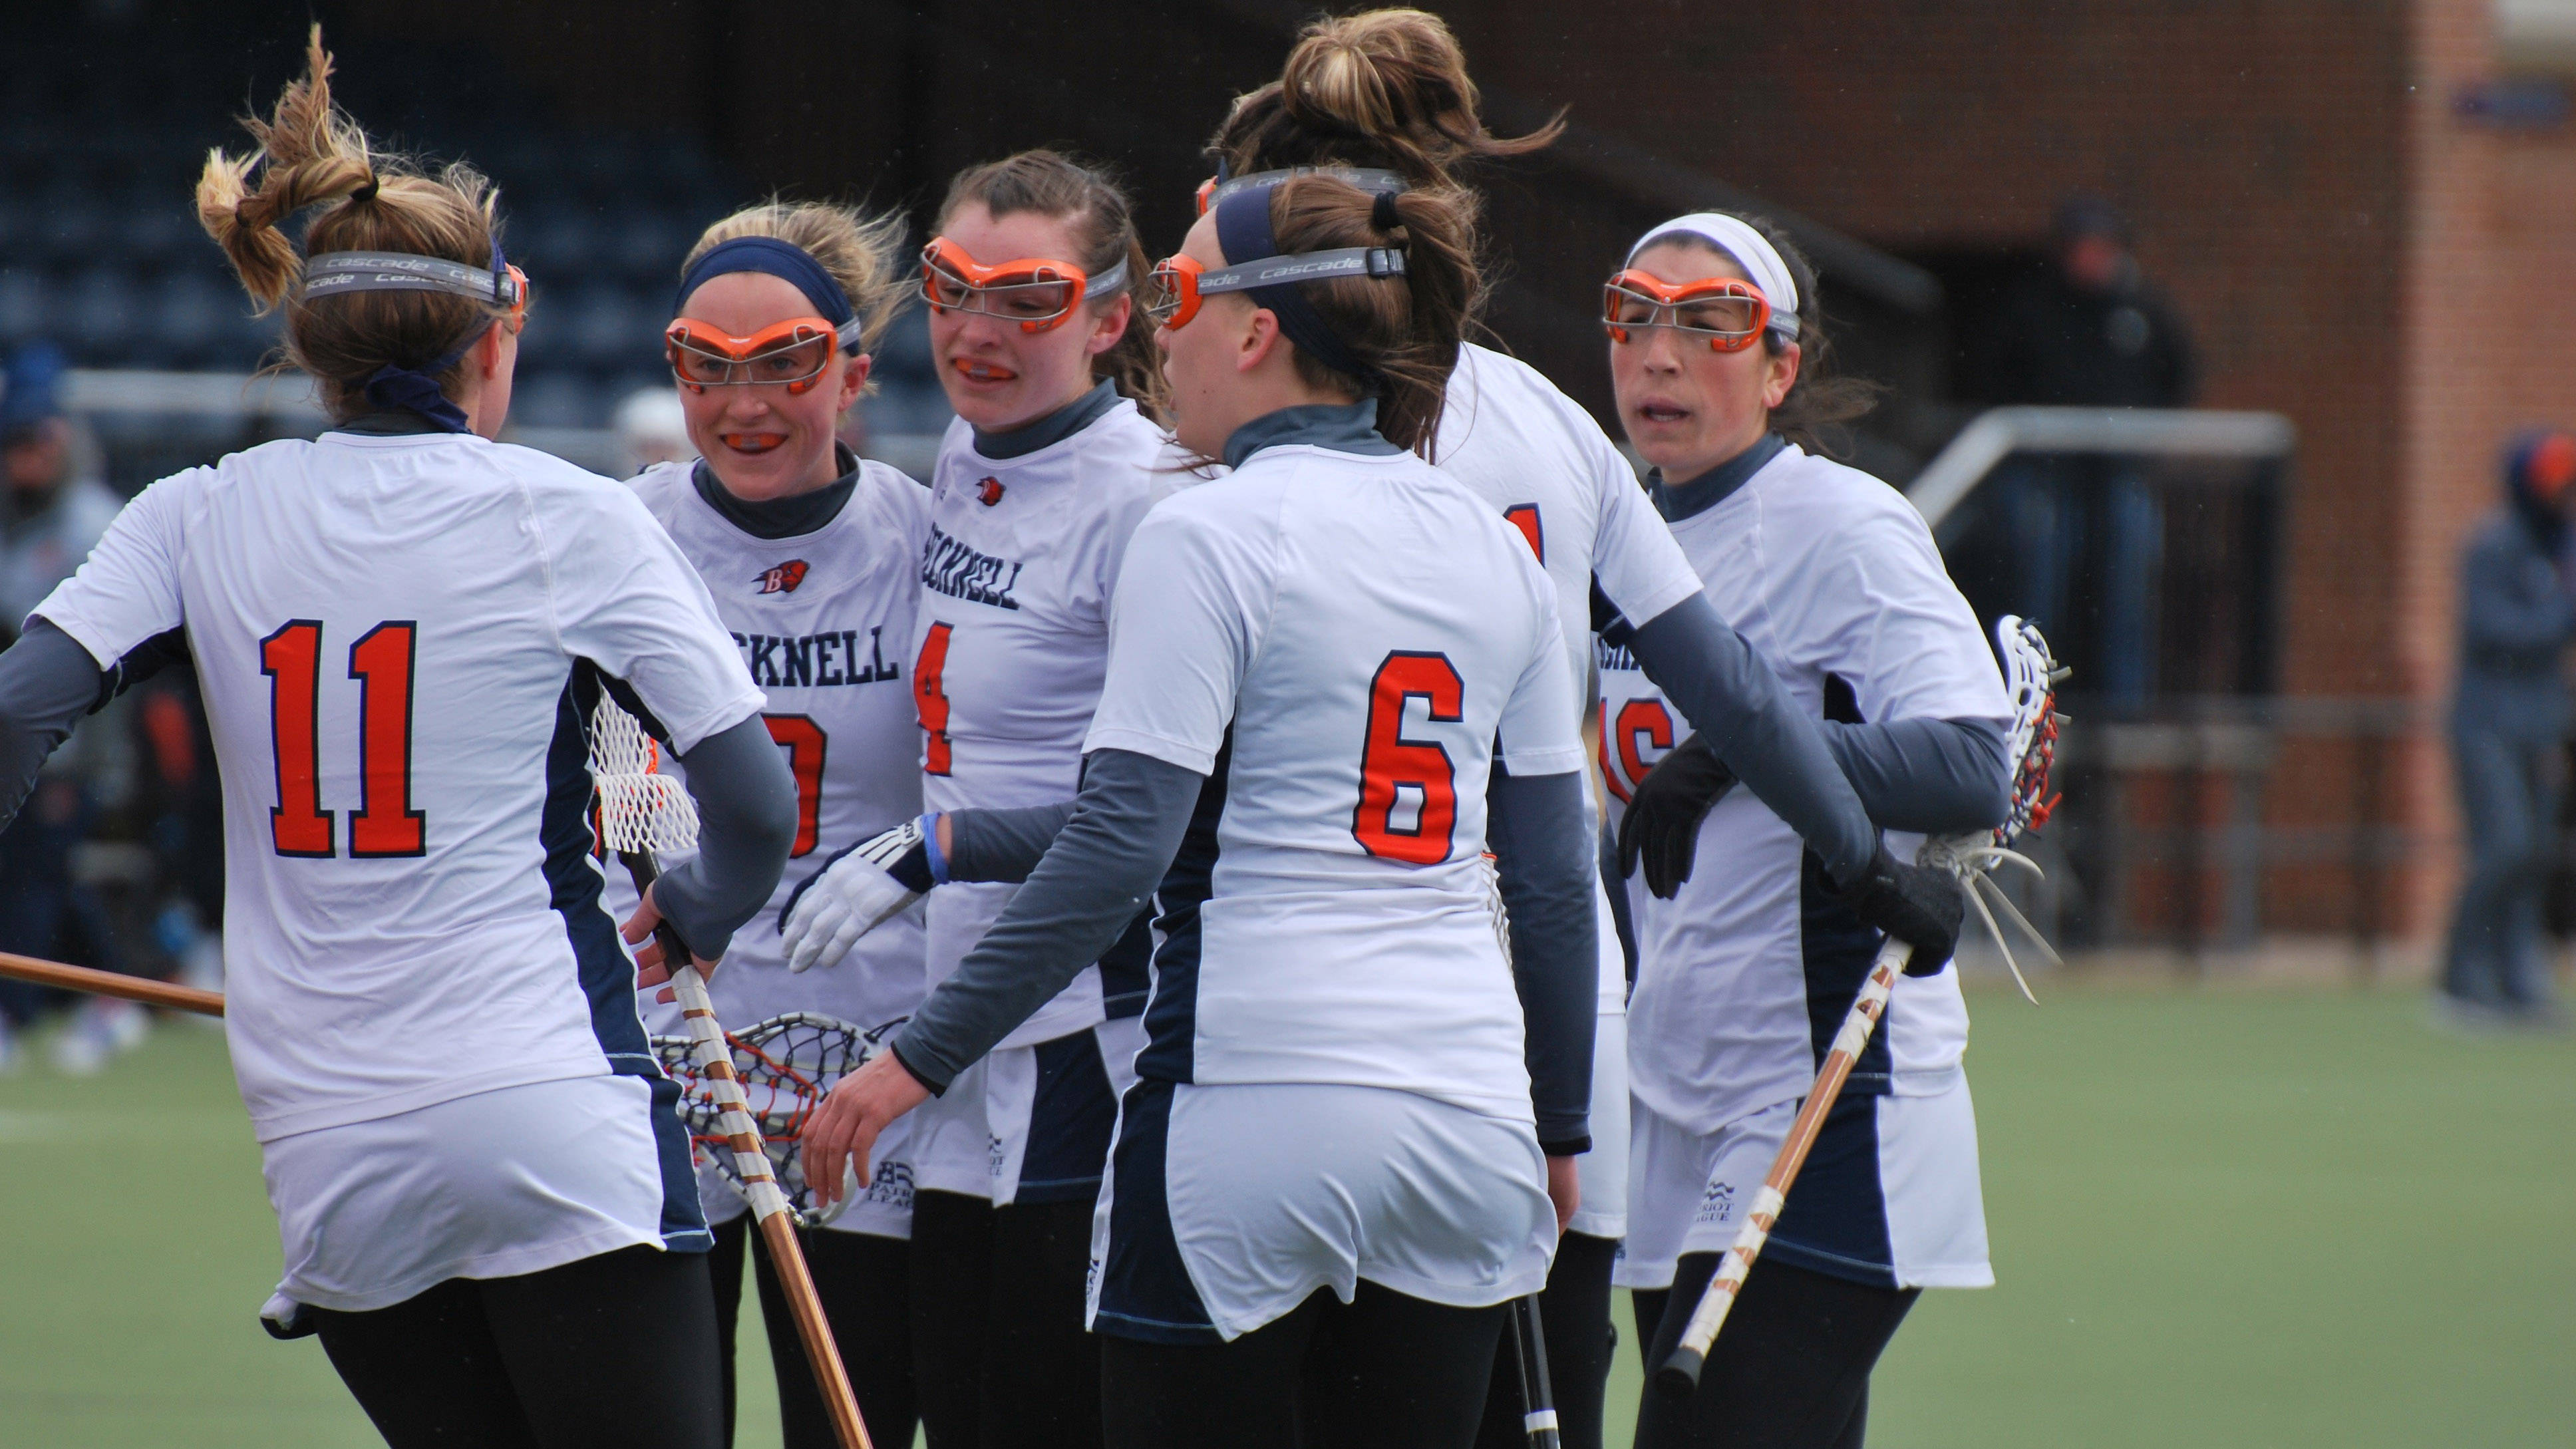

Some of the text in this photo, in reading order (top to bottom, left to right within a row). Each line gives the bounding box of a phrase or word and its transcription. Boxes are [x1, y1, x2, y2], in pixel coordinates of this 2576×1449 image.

[1260, 257, 1364, 279] cascade
[765, 569, 783, 592] B
[259, 618, 426, 859] 11
[1351, 649, 1465, 866] 6
